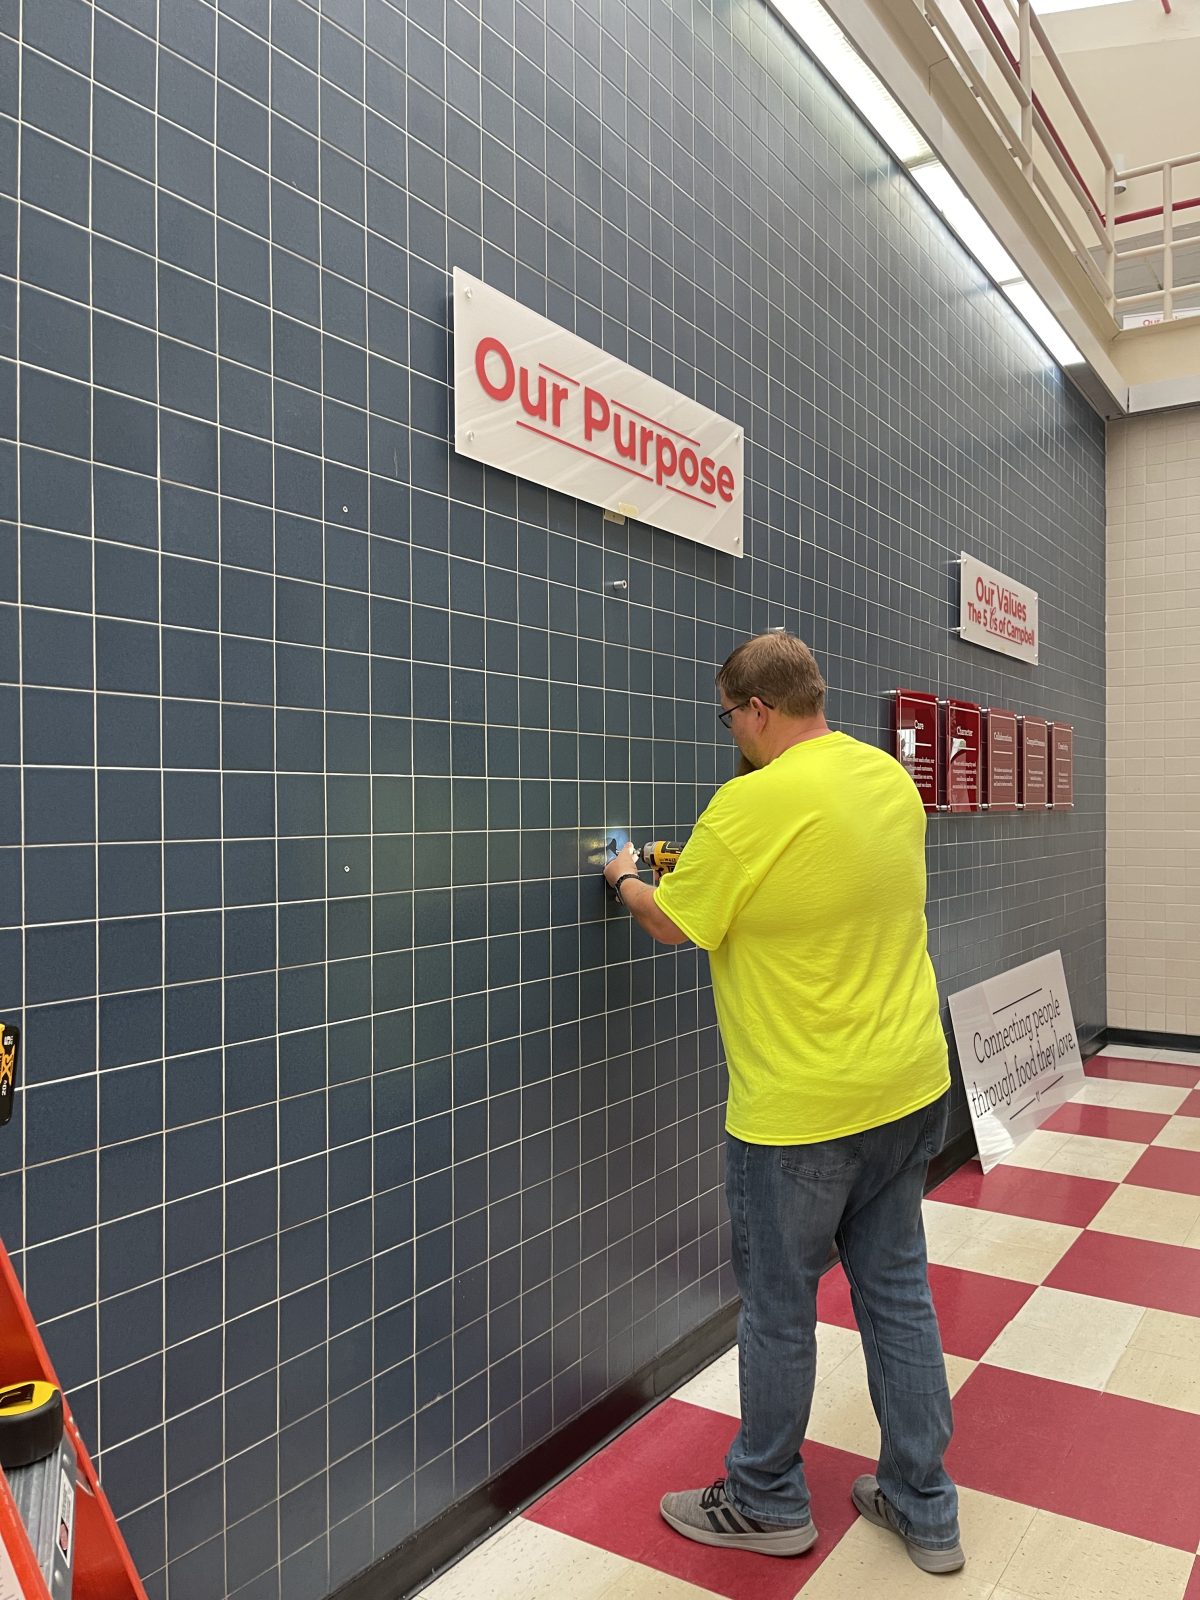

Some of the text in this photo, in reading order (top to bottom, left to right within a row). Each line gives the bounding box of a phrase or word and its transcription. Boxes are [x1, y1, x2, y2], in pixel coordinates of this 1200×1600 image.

[475, 337, 735, 503] Our Purpose
[968, 602, 982, 625] The
[983, 610, 988, 627] 5
[999, 616, 1007, 633] of
[1007, 620, 1035, 647] Campbell
[976, 576, 1027, 622] Our Values
[914, 719, 925, 730] Care
[973, 990, 1061, 1064] Connecting people
[971, 1031, 1076, 1119] through food they love.
